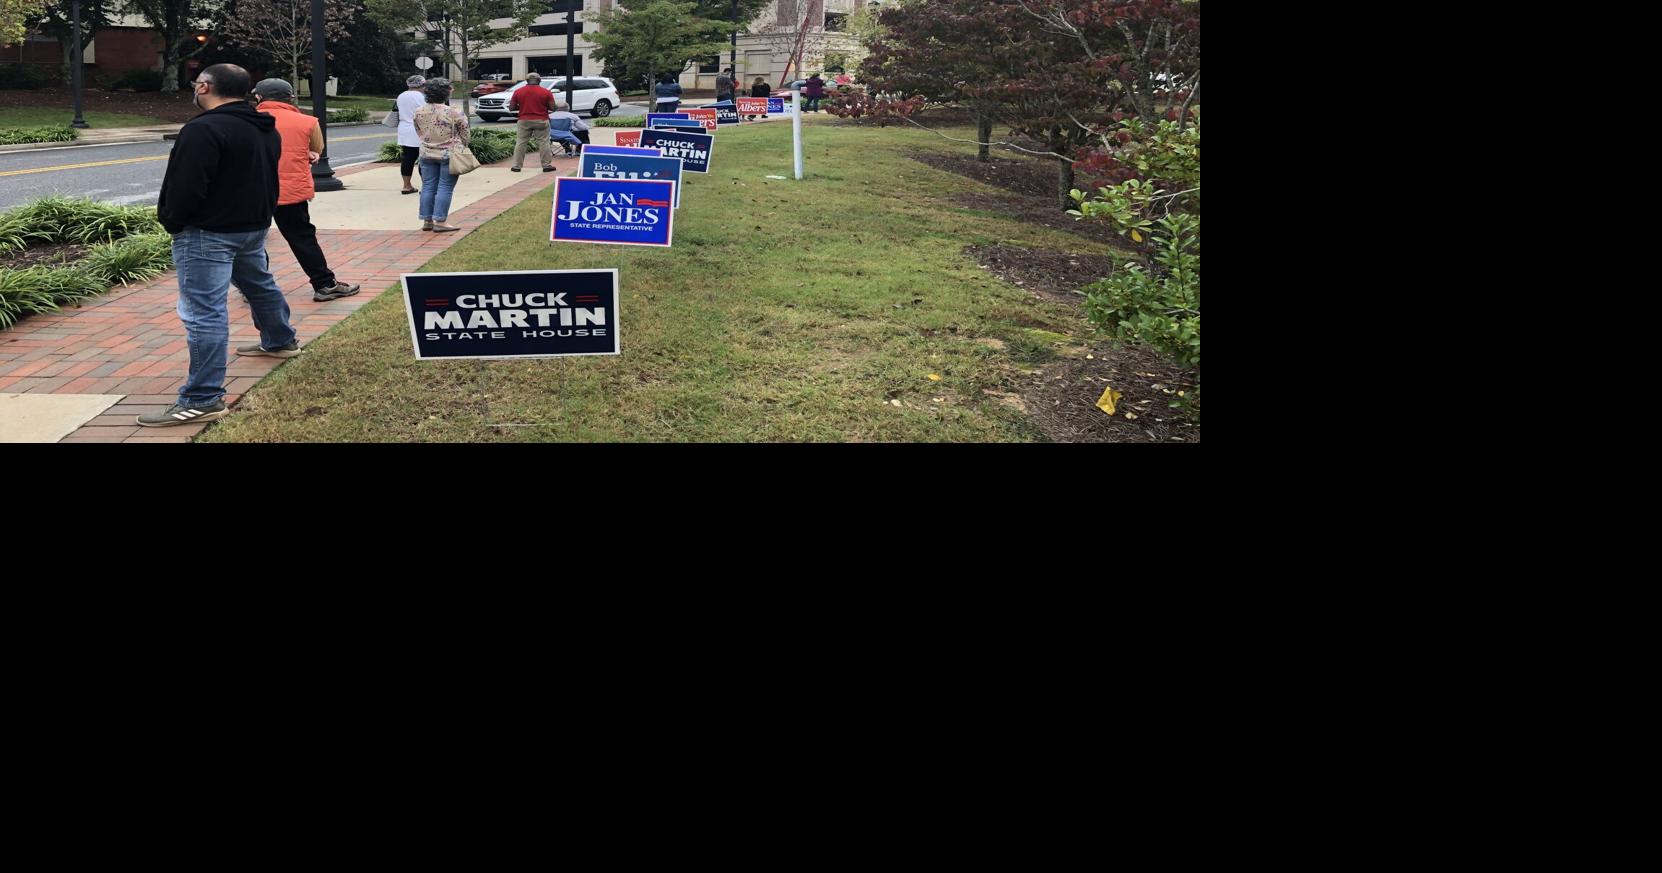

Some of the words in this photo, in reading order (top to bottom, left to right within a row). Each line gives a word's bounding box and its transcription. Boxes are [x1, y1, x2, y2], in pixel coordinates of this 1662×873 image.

[738, 103, 766, 112] Albers
[655, 139, 696, 149] CHUCK
[594, 162, 618, 171] Bob
[589, 192, 635, 206] JAN
[557, 200, 659, 225] JONES
[592, 222, 653, 232] REPRESENTATIVE
[455, 292, 568, 309] CHUCK
[424, 307, 606, 330] MARTIN
[425, 331, 506, 341] STATE
[522, 328, 607, 338] HOUSE
